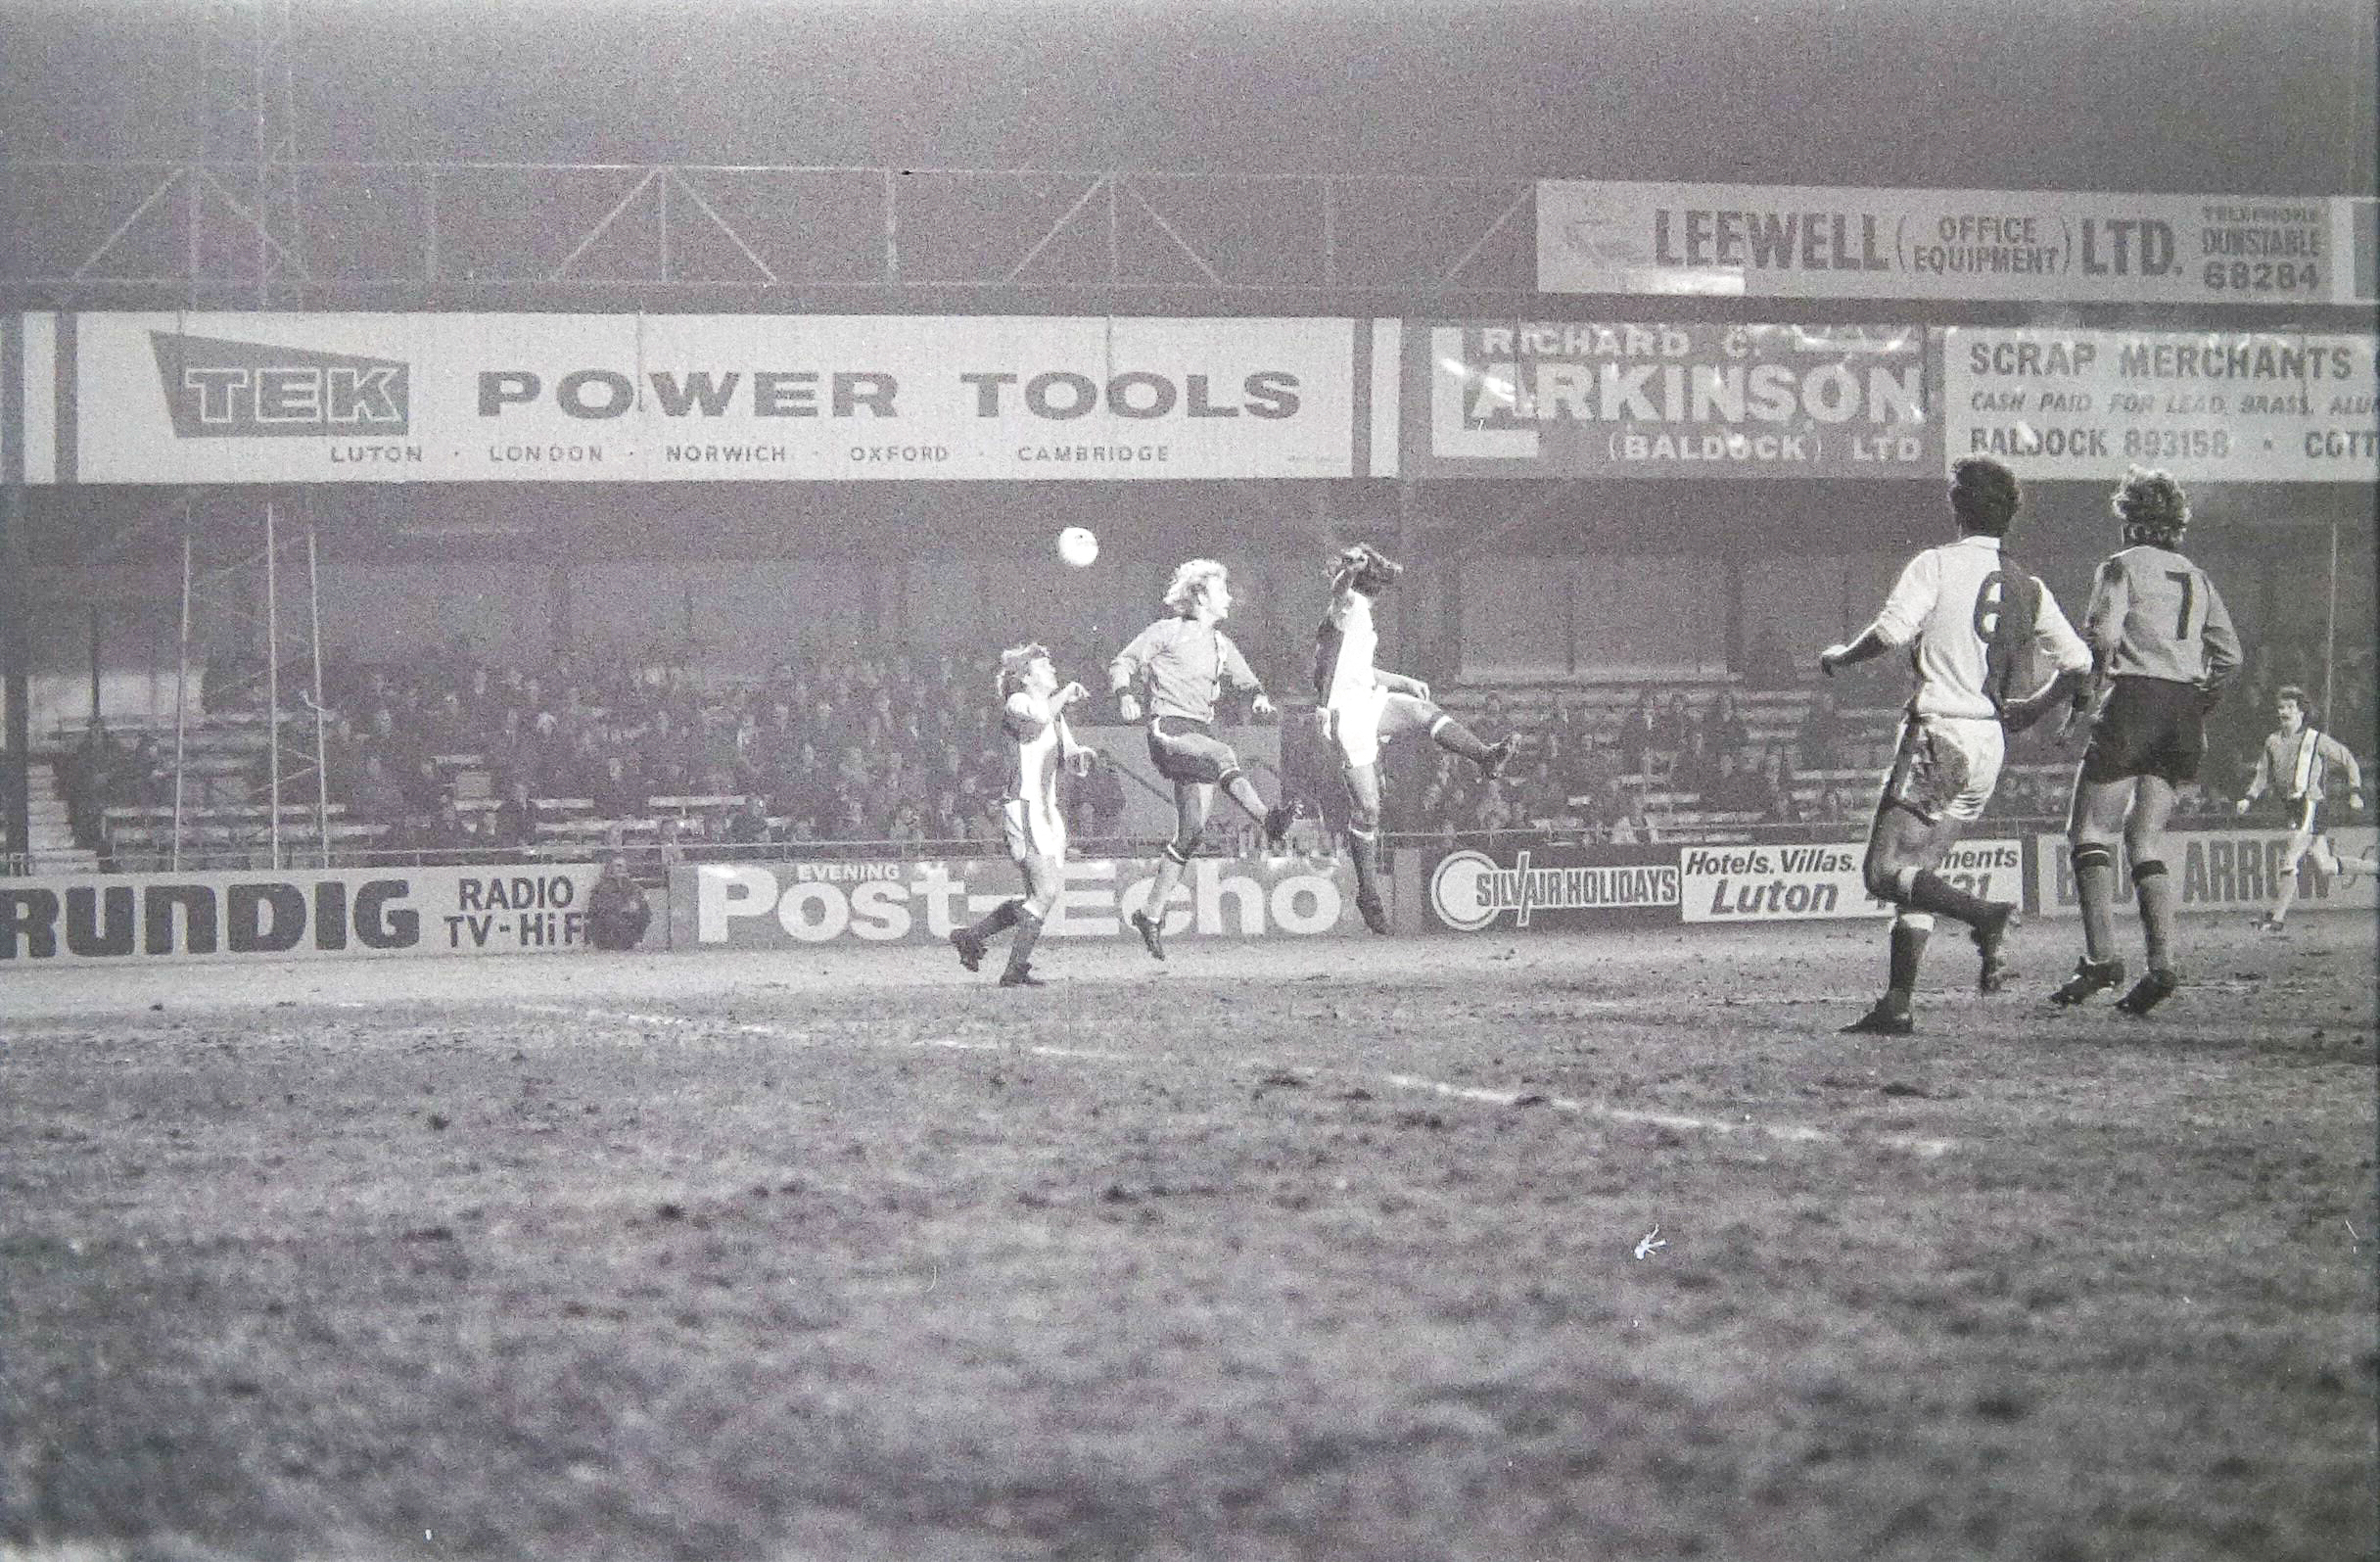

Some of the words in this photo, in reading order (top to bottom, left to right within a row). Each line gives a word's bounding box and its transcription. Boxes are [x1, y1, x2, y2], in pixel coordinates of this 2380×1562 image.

[1656, 209, 1889, 270] LEEWELL
[1938, 216, 2036, 243] OFFICE
[2202, 228, 2319, 257] DUNSTABLE
[1914, 246, 2059, 275] EQUIPMENT
[2082, 219, 2182, 276] LTD.
[1482, 325, 1690, 357] RICHARD
[1970, 342, 2097, 378] SCRAP
[2120, 344, 2353, 381] MERCHANTS
[186, 368, 403, 423] TEK
[478, 369, 900, 419] POWER
[960, 371, 1302, 420] TOOLS
[1970, 393, 2026, 412] CASH
[2038, 392, 2093, 412] PAID
[2329, 395, 2377, 414] ALU
[330, 444, 423, 463] LUTON
[490, 445, 604, 463] LONDON
[666, 445, 786, 463] NORWICH
[850, 445, 950, 464] OXFORD
[1016, 446, 1171, 464] CAMBRIDGE
[1853, 437, 1922, 462] LTD
[1971, 427, 2108, 456] BALDOCK
[2166, 571, 2194, 639] 7
[799, 864, 900, 881] EVENING
[1686, 850, 1775, 876] Hotels.
[1779, 848, 1857, 874] Villas.
[459, 878, 573, 910] RADIO
[1566, 870, 1677, 905] HOLIDAYS
[1709, 877, 1840, 915] Luton
[0, 881, 419, 958] RUNDIG
